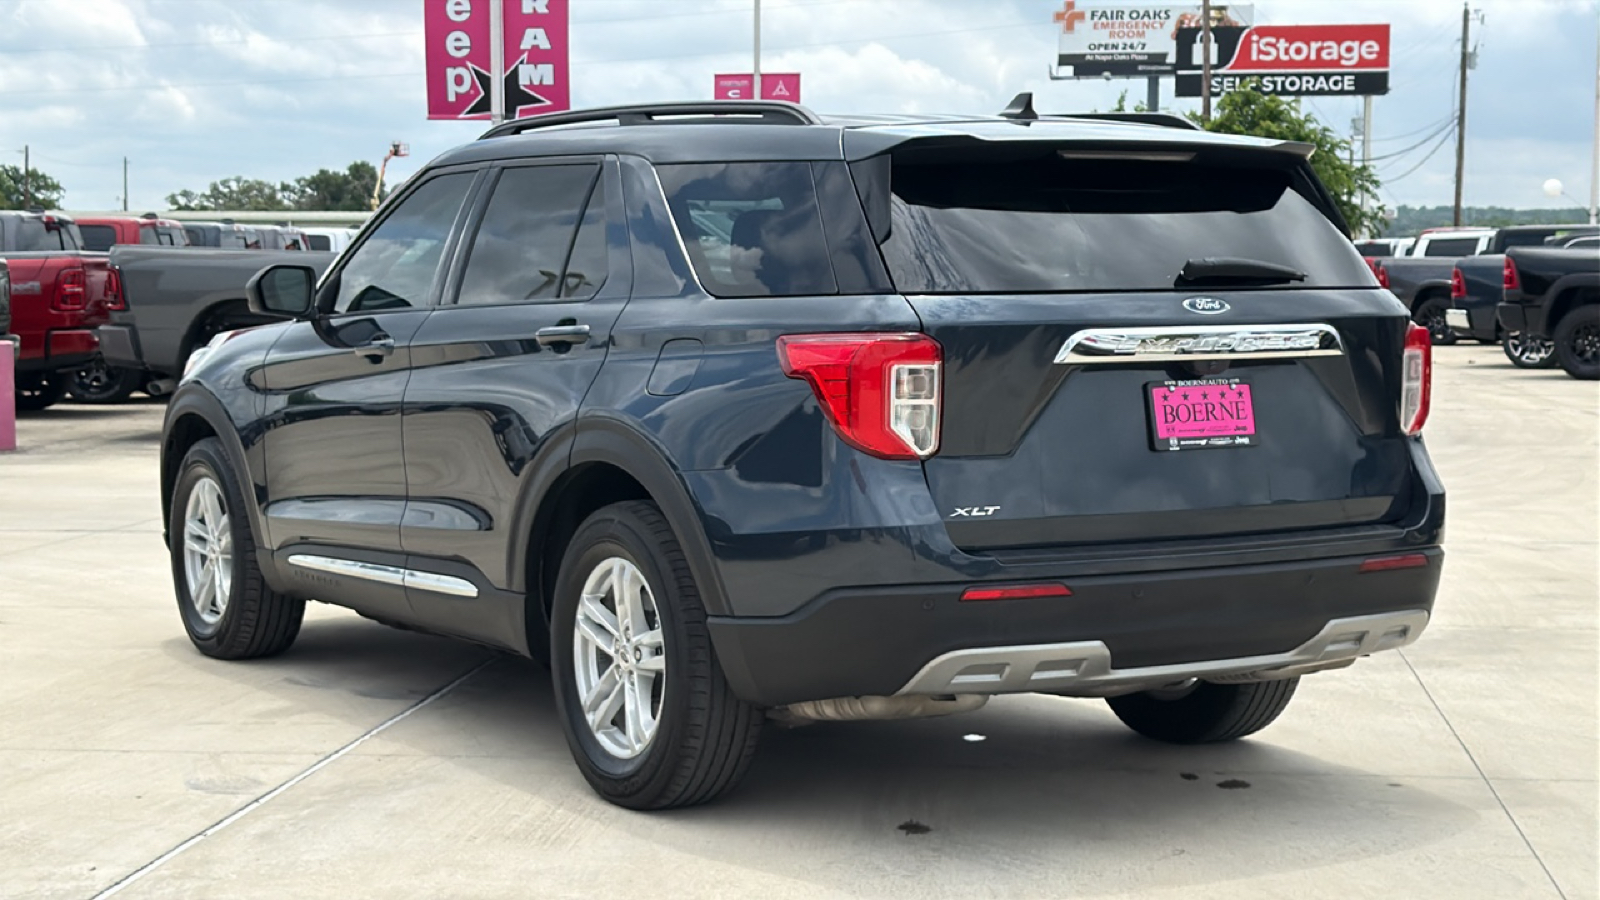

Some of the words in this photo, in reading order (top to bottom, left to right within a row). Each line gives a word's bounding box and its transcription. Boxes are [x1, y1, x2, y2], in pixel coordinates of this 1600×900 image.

[1090, 10, 1126, 20] FAIR
[1129, 9, 1171, 20] OAKS
[1093, 21, 1166, 30] EMERGENCY
[1109, 30, 1146, 39] ROOM
[1088, 43, 1120, 51] OPEN
[1121, 42, 1147, 51] 24/7
[1250, 35, 1380, 66] iStorage
[1262, 75, 1356, 92] STORAGE
[1195, 299, 1221, 310] Ford
[1162, 401, 1249, 425] BOERNE
[949, 505, 1001, 517] XLT
